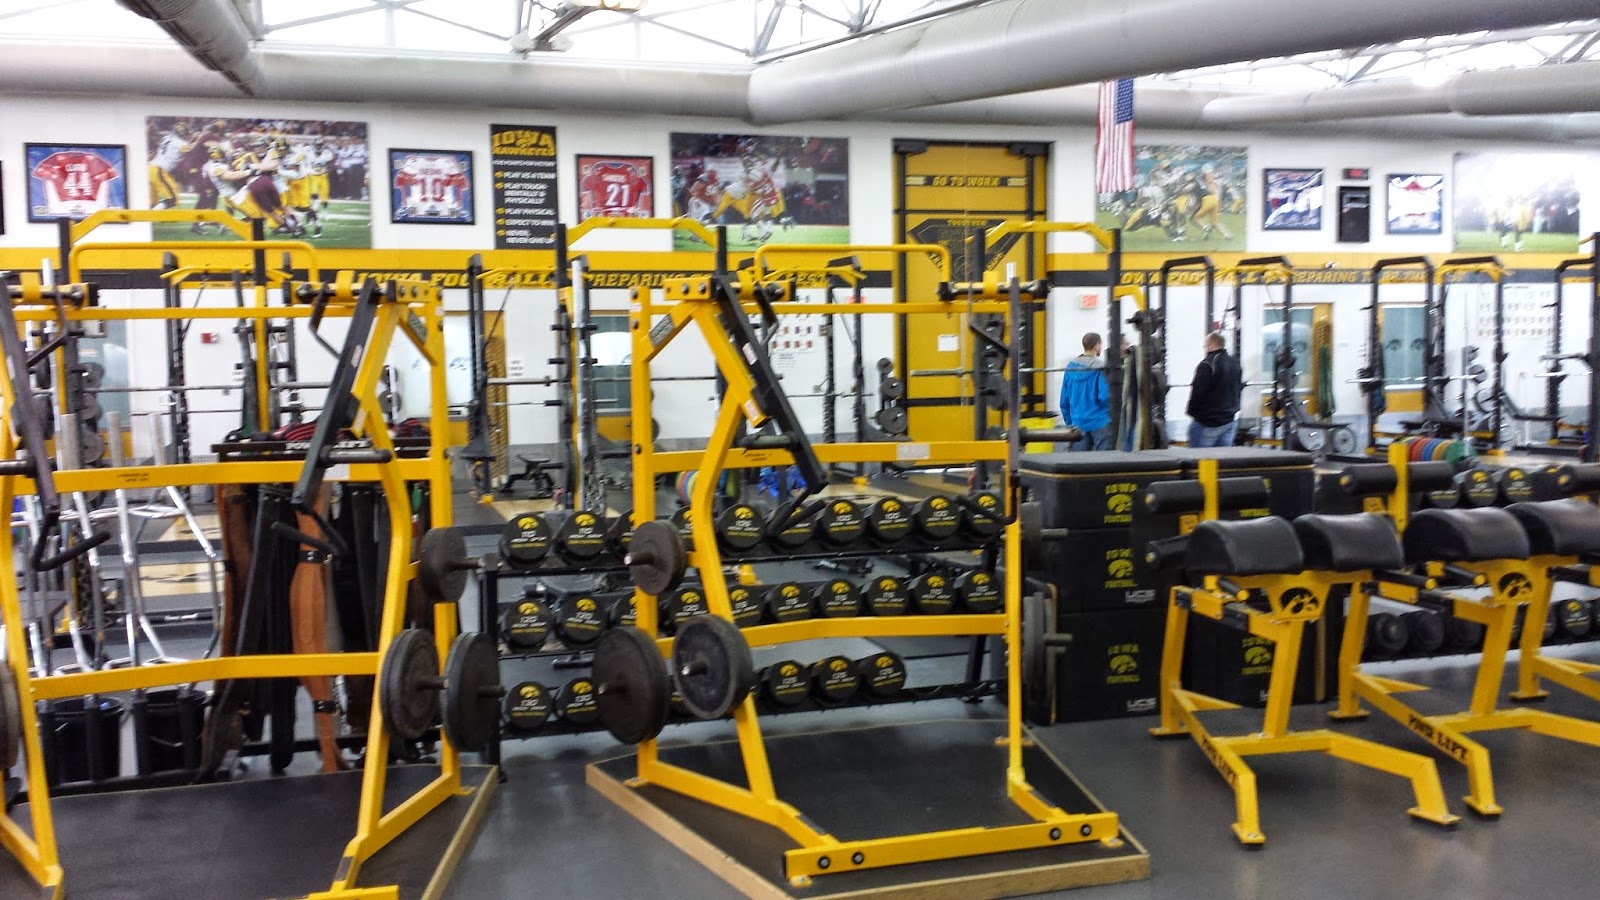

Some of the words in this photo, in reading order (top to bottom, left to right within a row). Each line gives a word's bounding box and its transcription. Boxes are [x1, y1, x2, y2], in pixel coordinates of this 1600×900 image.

[492, 130, 555, 148] IOWA
[62, 171, 93, 196] 44
[419, 178, 445, 202] 10
[932, 176, 947, 187] GO
[950, 176, 963, 187] TO
[967, 176, 1000, 187] WORK
[605, 183, 630, 206] 21
